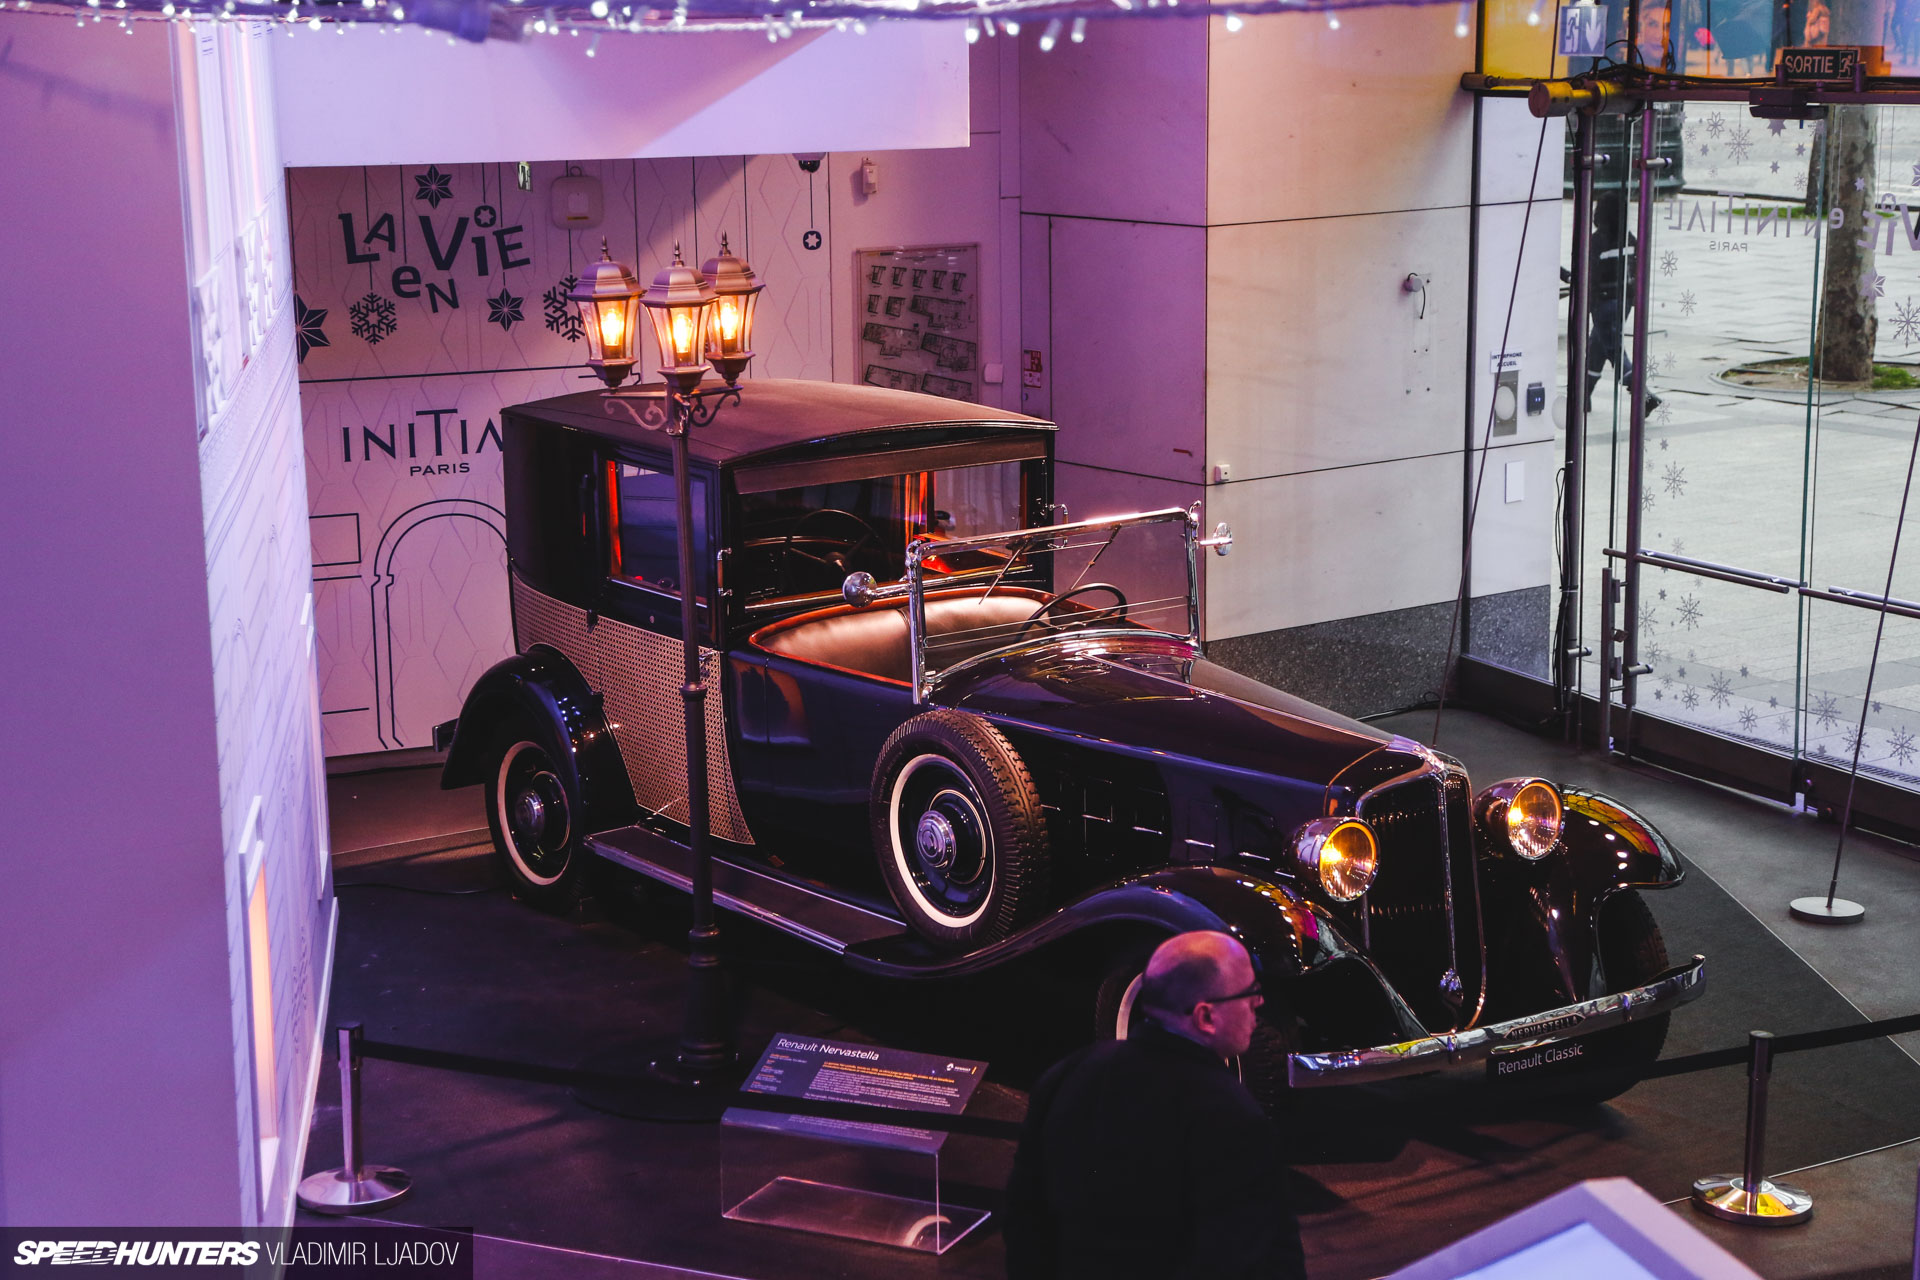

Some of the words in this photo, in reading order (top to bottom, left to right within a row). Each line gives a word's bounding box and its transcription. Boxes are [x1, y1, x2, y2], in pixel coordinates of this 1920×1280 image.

[1785, 55, 1834, 73] SORTIE
[338, 213, 396, 264] LA
[409, 463, 471, 477] PARIS
[1511, 1016, 1579, 1037] NERVASTELLA
[777, 1038, 818, 1052] Renault
[818, 1044, 880, 1061] Nervastella
[1498, 1053, 1542, 1076] Renault
[1545, 1043, 1584, 1063] Classic
